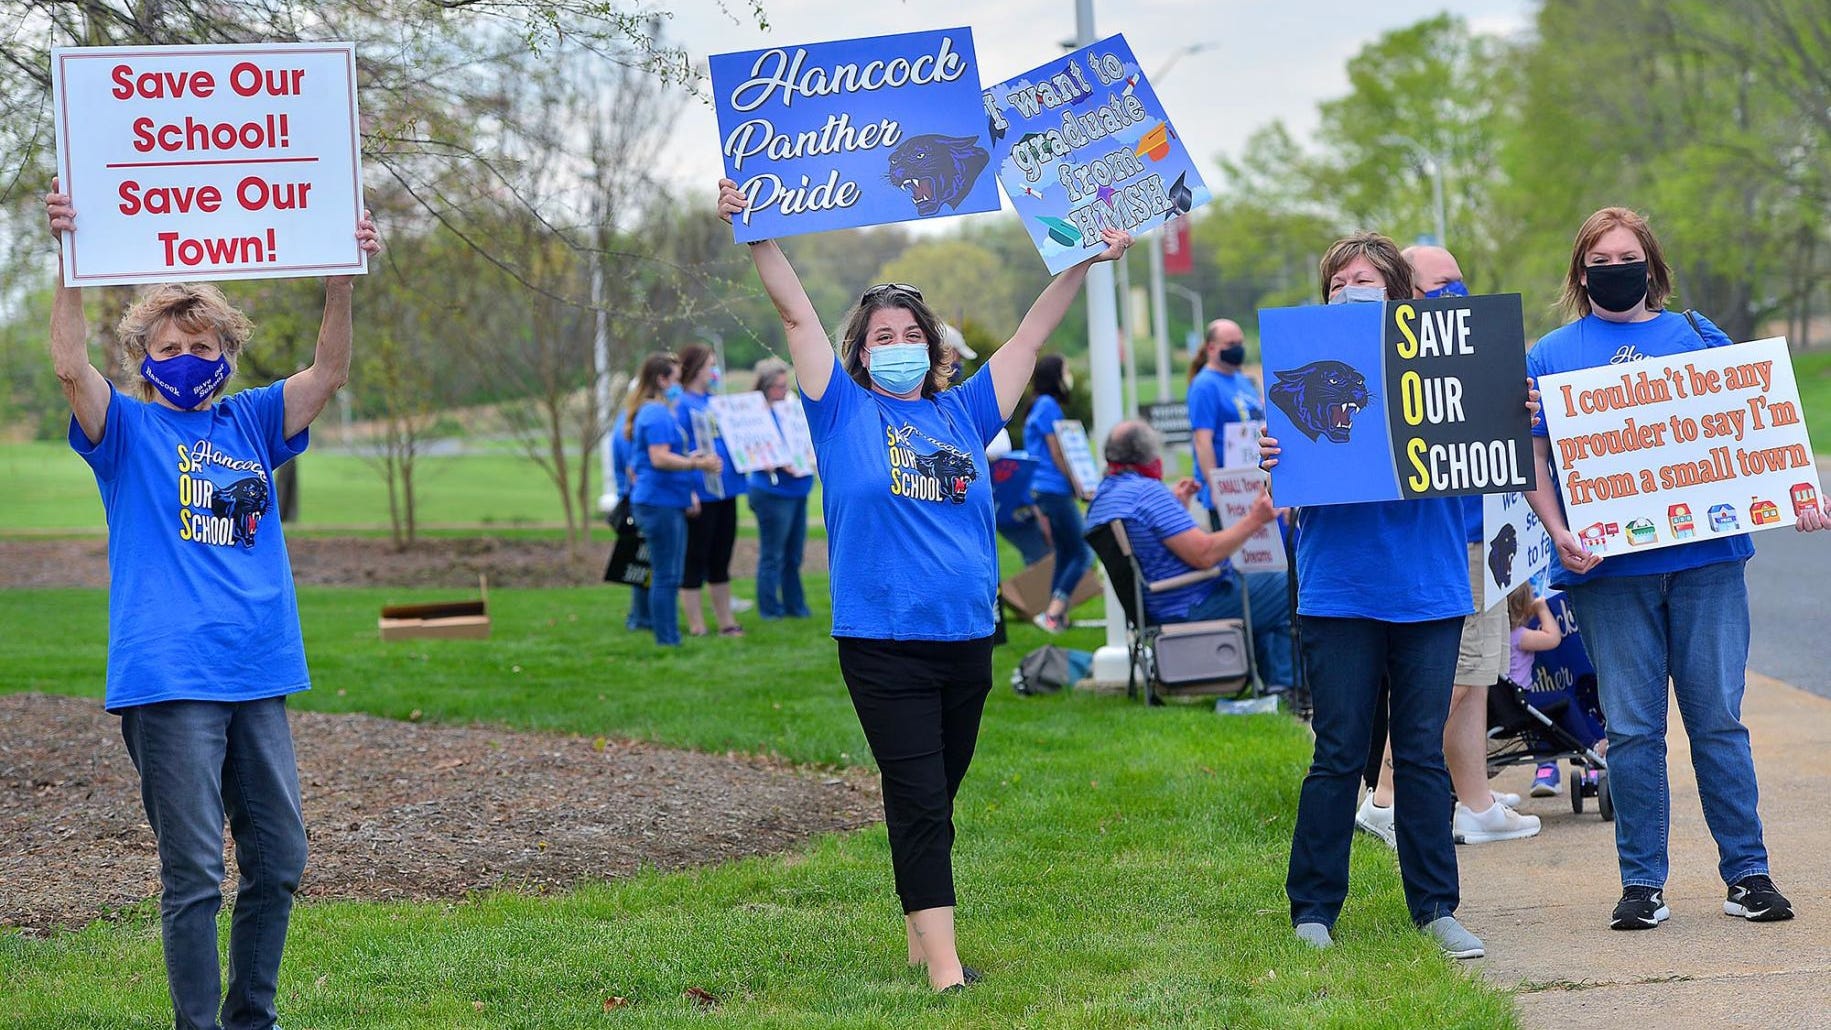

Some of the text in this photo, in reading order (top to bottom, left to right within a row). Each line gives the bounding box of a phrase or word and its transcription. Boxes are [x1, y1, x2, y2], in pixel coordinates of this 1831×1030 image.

[111, 62, 305, 100] Save Our
[731, 37, 967, 112] Hancock
[983, 51, 1125, 130] I want to
[133, 114, 289, 153] School!
[725, 113, 902, 171] Panther
[1011, 92, 1145, 183] graduate
[118, 176, 312, 216] Save Our
[738, 169, 862, 226] Pride
[1058, 147, 1144, 202] from
[1069, 174, 1173, 247] HMSH
[158, 228, 277, 267] Town!
[1395, 304, 1474, 359] SAVE
[145, 366, 181, 397] Hancock
[193, 363, 224, 395] Save Our
[199, 373, 224, 398] School
[1401, 370, 1465, 426] OUR
[1560, 360, 1772, 417] I couldn't be any
[1557, 396, 1799, 470] prouder to say I'm
[891, 468, 943, 501] SCHOOL
[1407, 437, 1526, 493] SCHOOL
[1566, 443, 1810, 505] from a small town
[179, 509, 235, 545] SCHOOL
[1526, 512, 1537, 532] se
[1527, 531, 1551, 567] to fa
